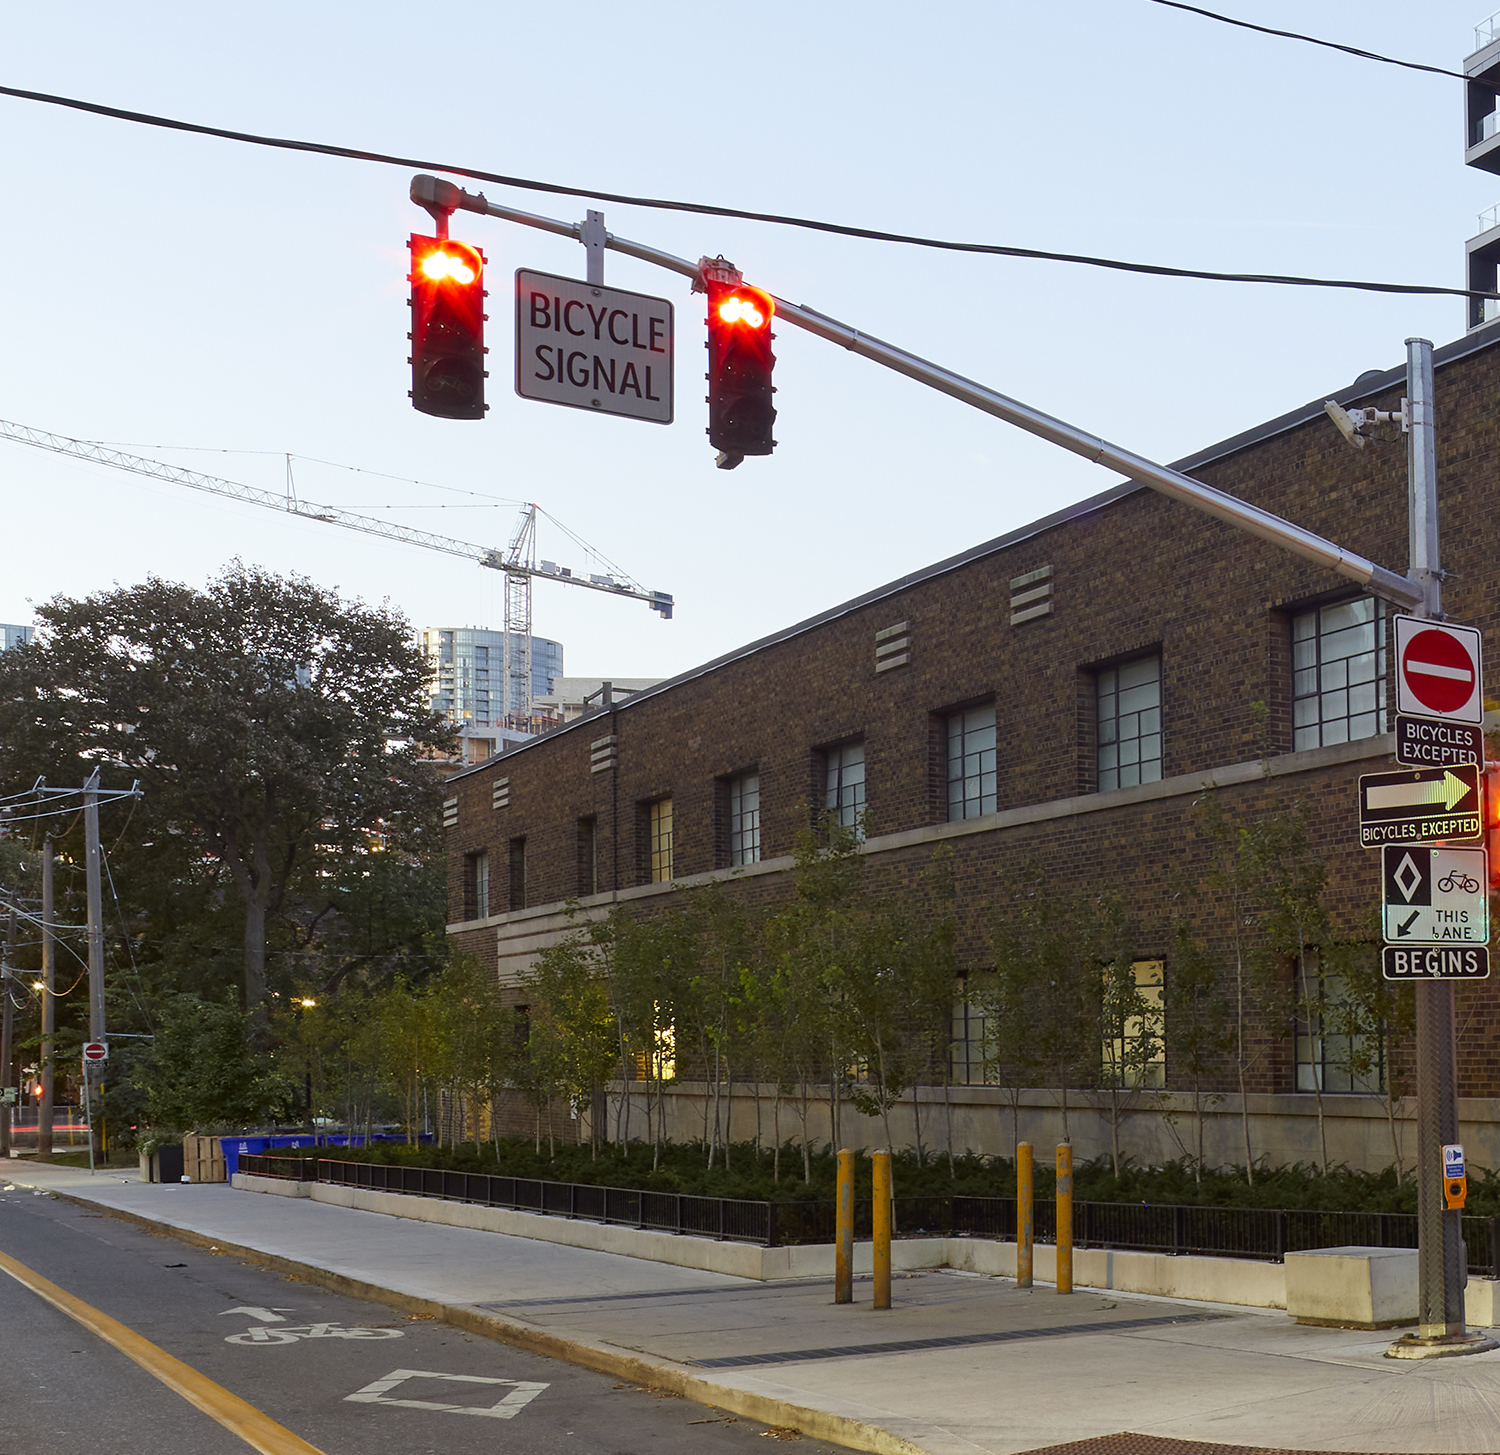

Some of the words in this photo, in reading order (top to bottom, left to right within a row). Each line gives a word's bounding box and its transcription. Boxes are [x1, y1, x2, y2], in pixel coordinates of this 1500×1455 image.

[530, 292, 666, 353] BICYCLE
[534, 344, 660, 401] SIGNAL
[1406, 723, 1473, 746] BICYCLES
[1403, 742, 1477, 765] EXCEPTED
[1362, 823, 1416, 842] BICYCLES
[1421, 817, 1479, 836] EXCEPTED
[1436, 910, 1469, 923] THIS
[1432, 926, 1472, 939] LANE
[1395, 950, 1478, 975] BEGINS
